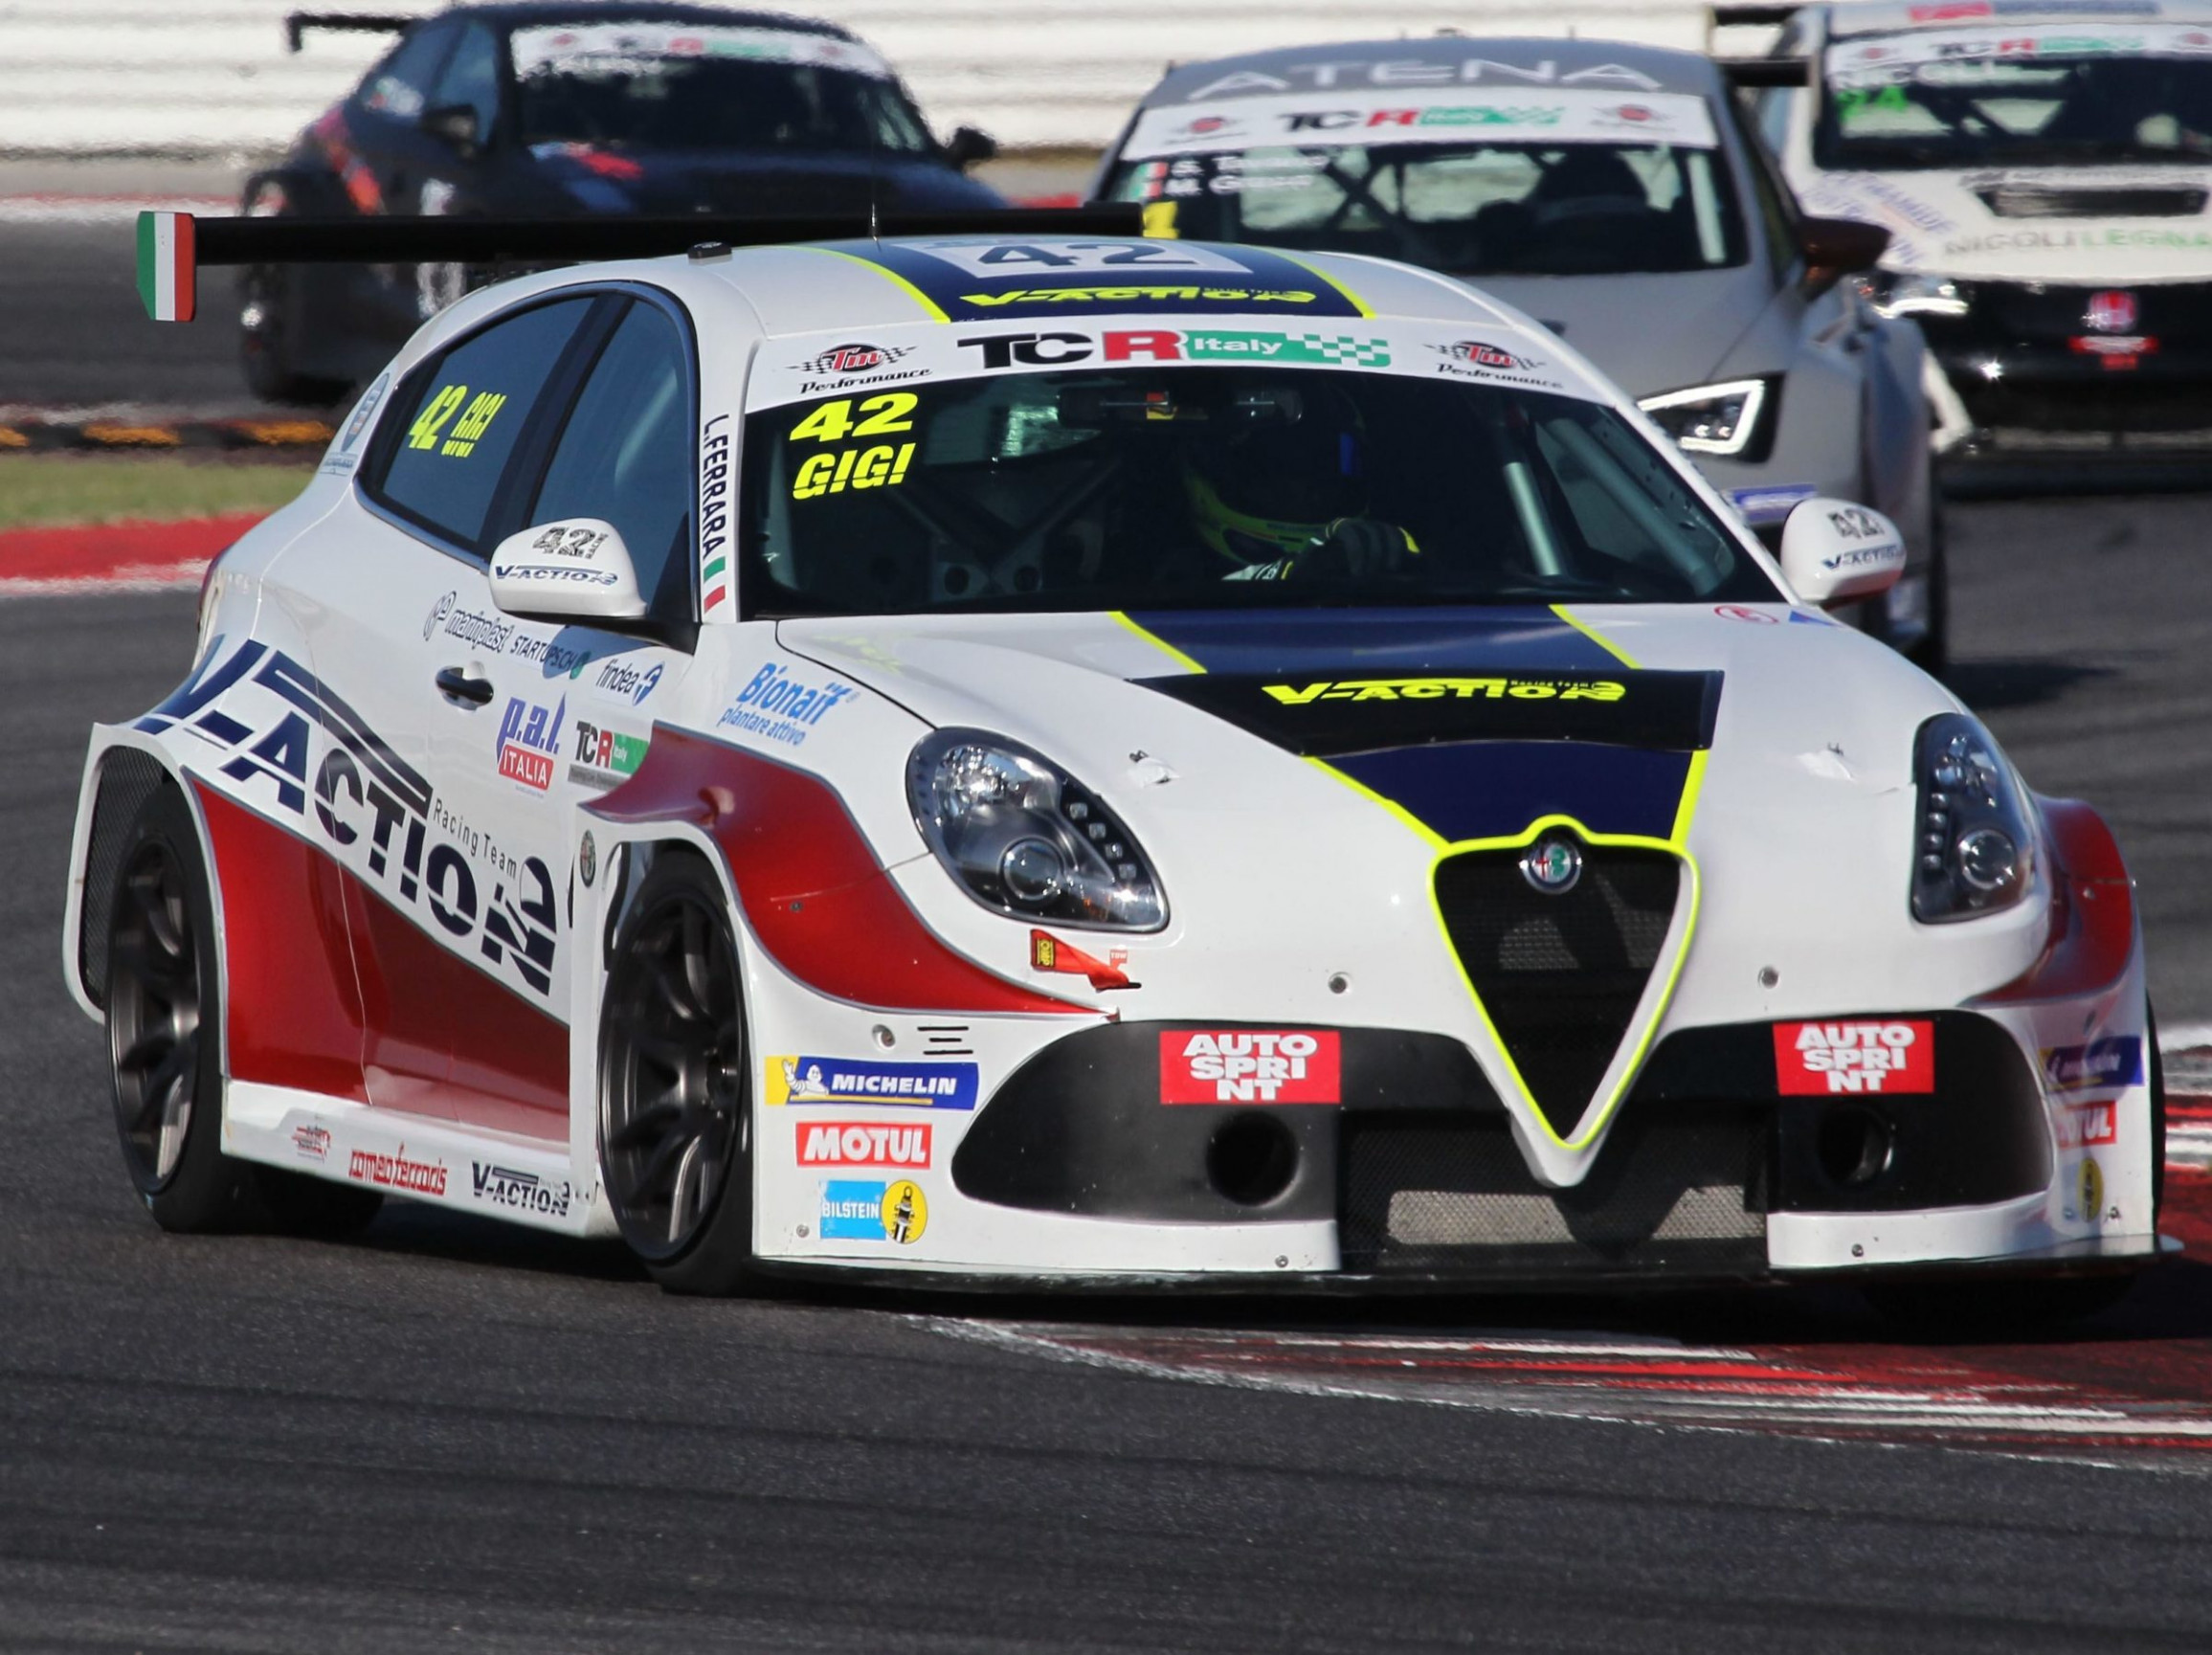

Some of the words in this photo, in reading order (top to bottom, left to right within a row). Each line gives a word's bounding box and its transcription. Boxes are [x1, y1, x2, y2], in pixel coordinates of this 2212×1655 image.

[1189, 58, 1663, 100] ATENA
[1279, 108, 1420, 131] TCR
[978, 244, 1198, 266] 42
[958, 330, 1185, 370] TCR
[1194, 337, 1284, 355] Italy
[800, 368, 933, 394] Performance
[1437, 363, 1564, 388] Performance
[409, 385, 467, 450] 42
[441, 391, 507, 458] GIGI
[790, 392, 918, 442] 42
[793, 442, 916, 501] GIGI
[532, 526, 595, 558] 42
[595, 659, 640, 695] findea
[716, 704, 771, 735] plantare
[766, 720, 806, 746] attivo
[575, 720, 613, 770] TCR
[614, 747, 629, 764] Italy
[503, 749, 547, 786] ITALIA
[433, 797, 479, 858] Racing
[483, 833, 518, 880] Team
[1183, 1034, 1318, 1057] AUTO
[1795, 1023, 1915, 1050] AUTO
[1190, 1056, 1308, 1080] SPRI
[1802, 1047, 1907, 1071] SPRI
[832, 1073, 957, 1095] MICHELIN
[1217, 1079, 1283, 1101] NT
[1826, 1070, 1887, 1092] NT
[803, 1126, 927, 1164] MOTUL
[822, 1201, 881, 1219] BILSTEIN
